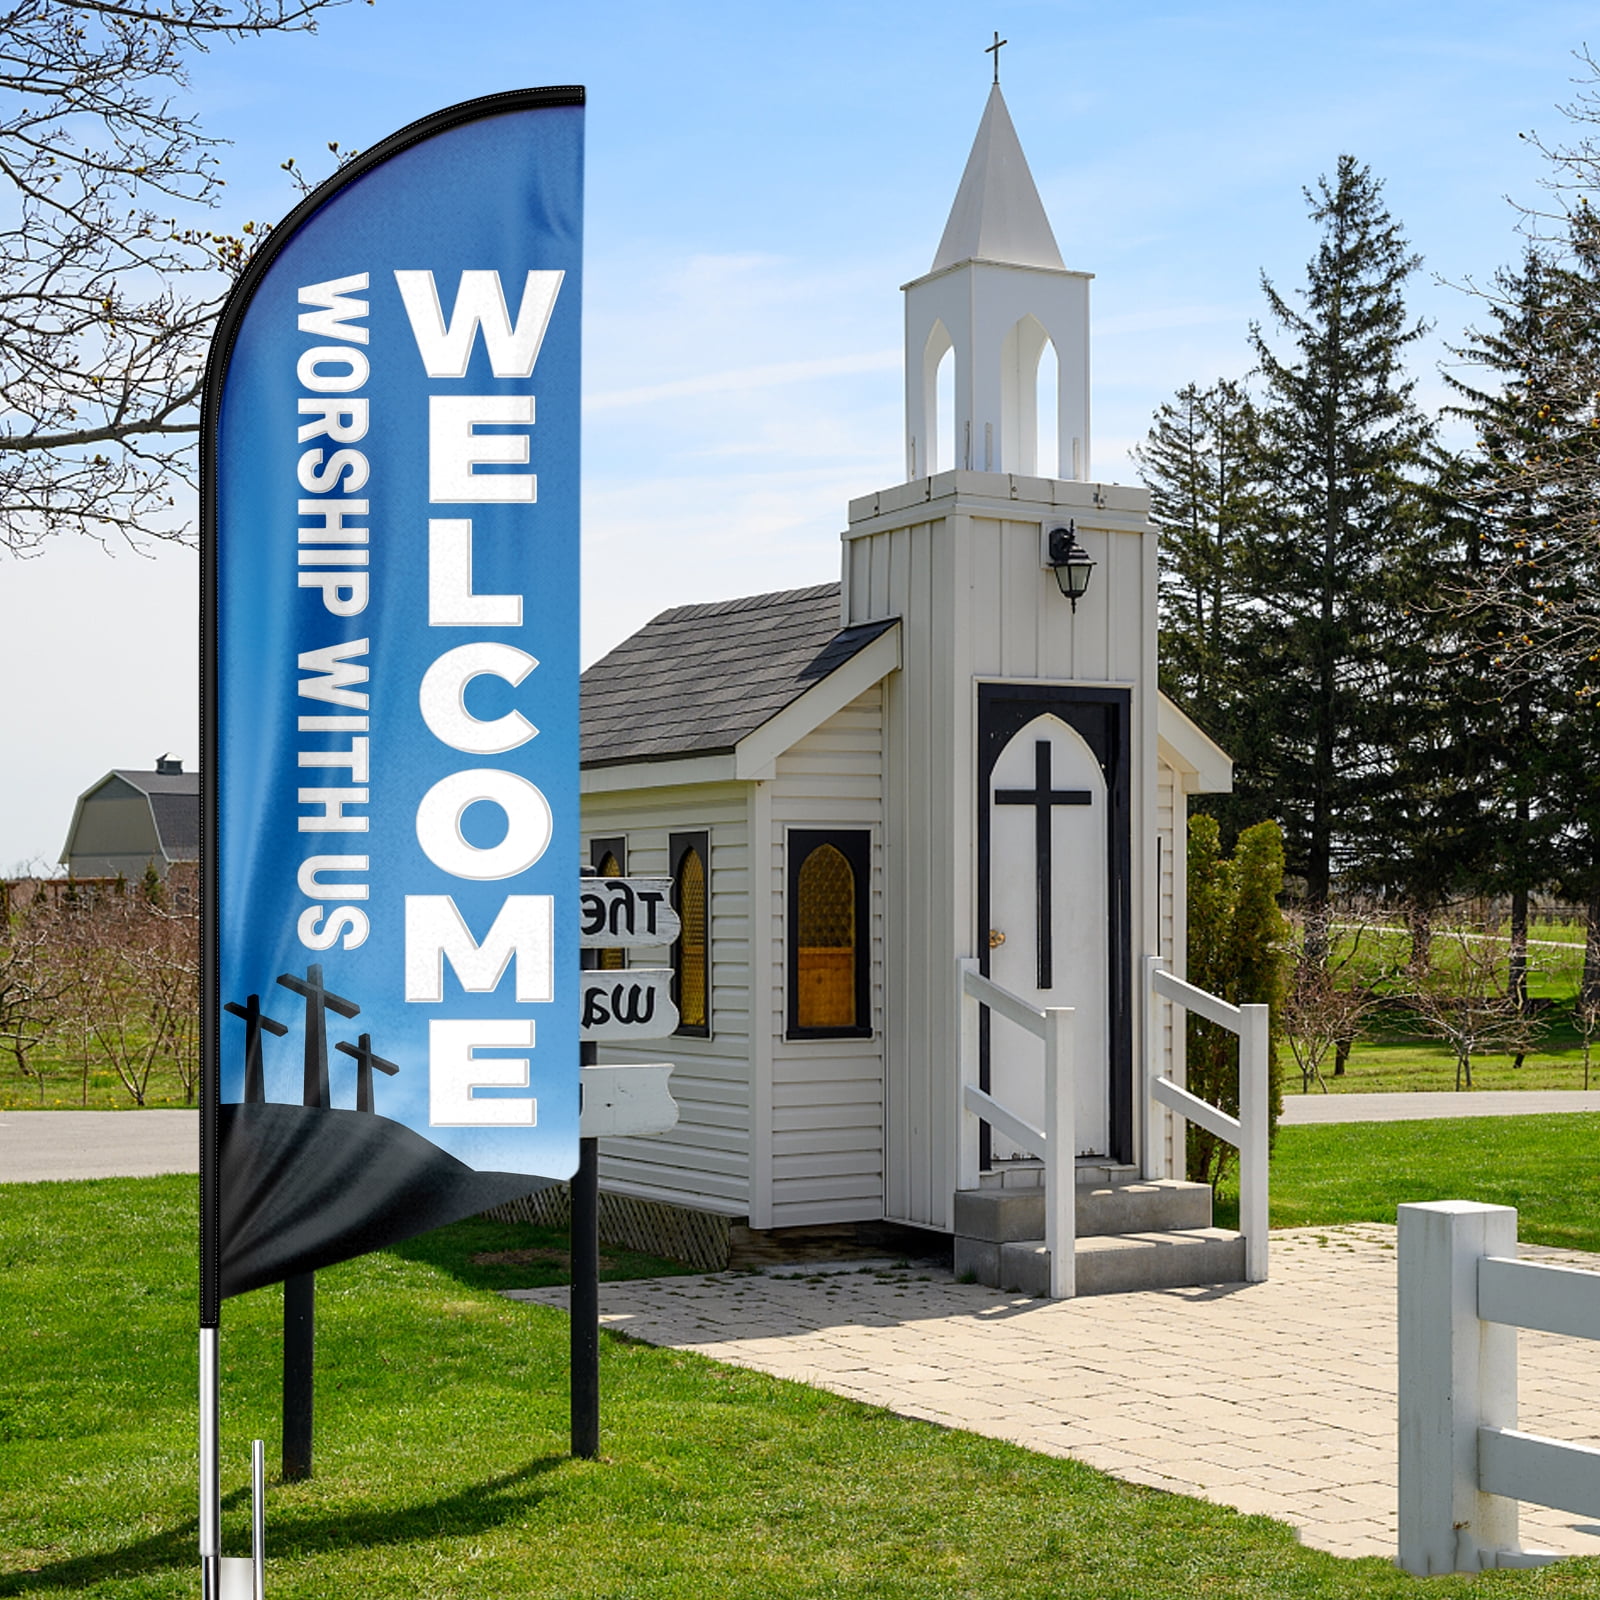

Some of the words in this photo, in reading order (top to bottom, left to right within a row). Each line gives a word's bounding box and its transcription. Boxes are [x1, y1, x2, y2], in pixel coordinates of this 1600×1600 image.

[297, 271, 370, 617] WORSHIP
[297, 637, 370, 834] WITH
[393, 269, 566, 1128] WELCOME
[297, 853, 371, 951] US
